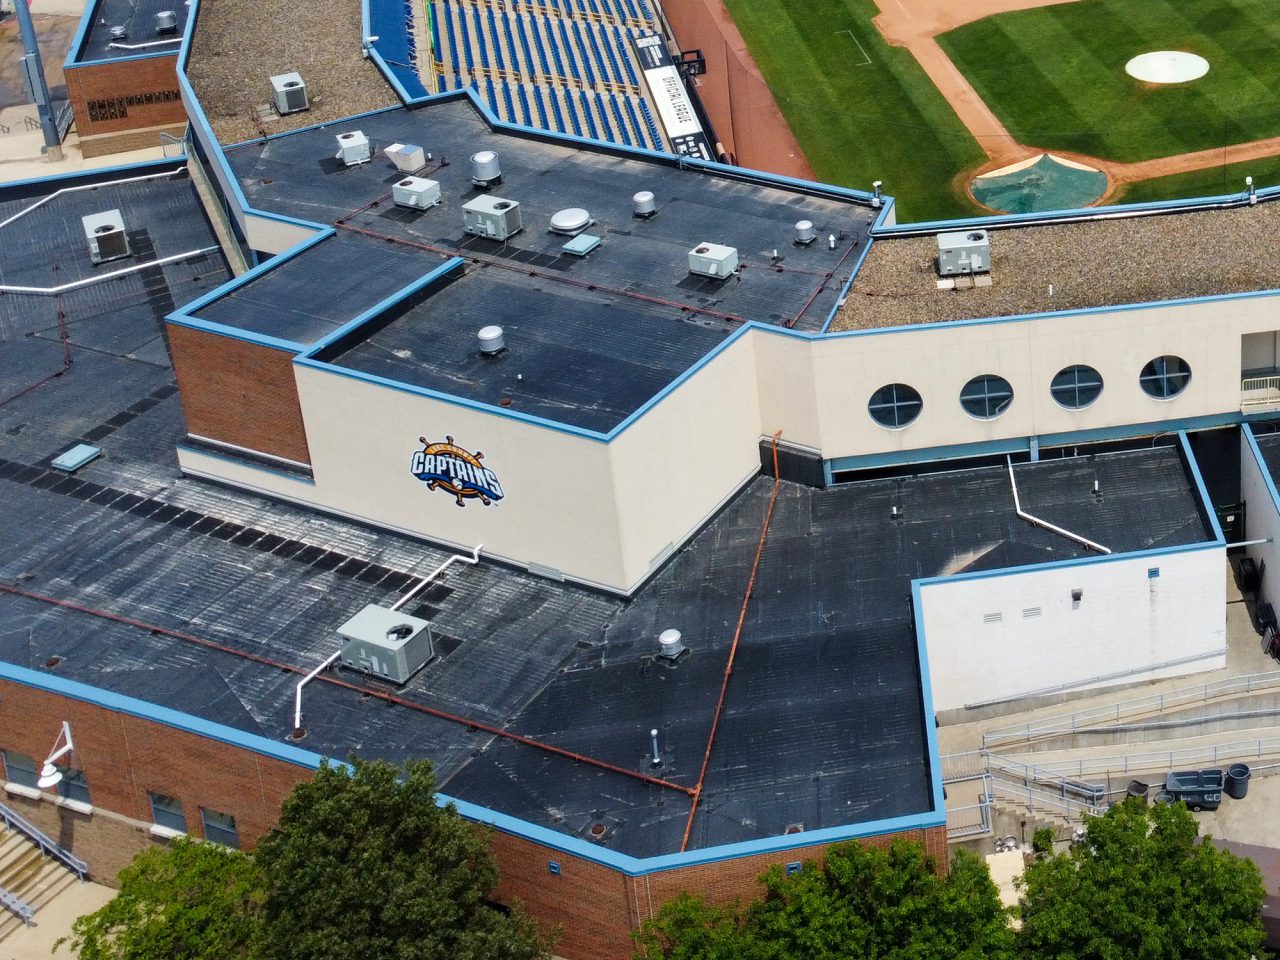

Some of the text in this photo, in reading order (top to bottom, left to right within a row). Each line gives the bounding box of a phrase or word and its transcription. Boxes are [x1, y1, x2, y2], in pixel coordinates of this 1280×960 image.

[662, 76, 692, 124] OFFICIAL LEAGUE
[412, 451, 504, 499] CAPTAINS
